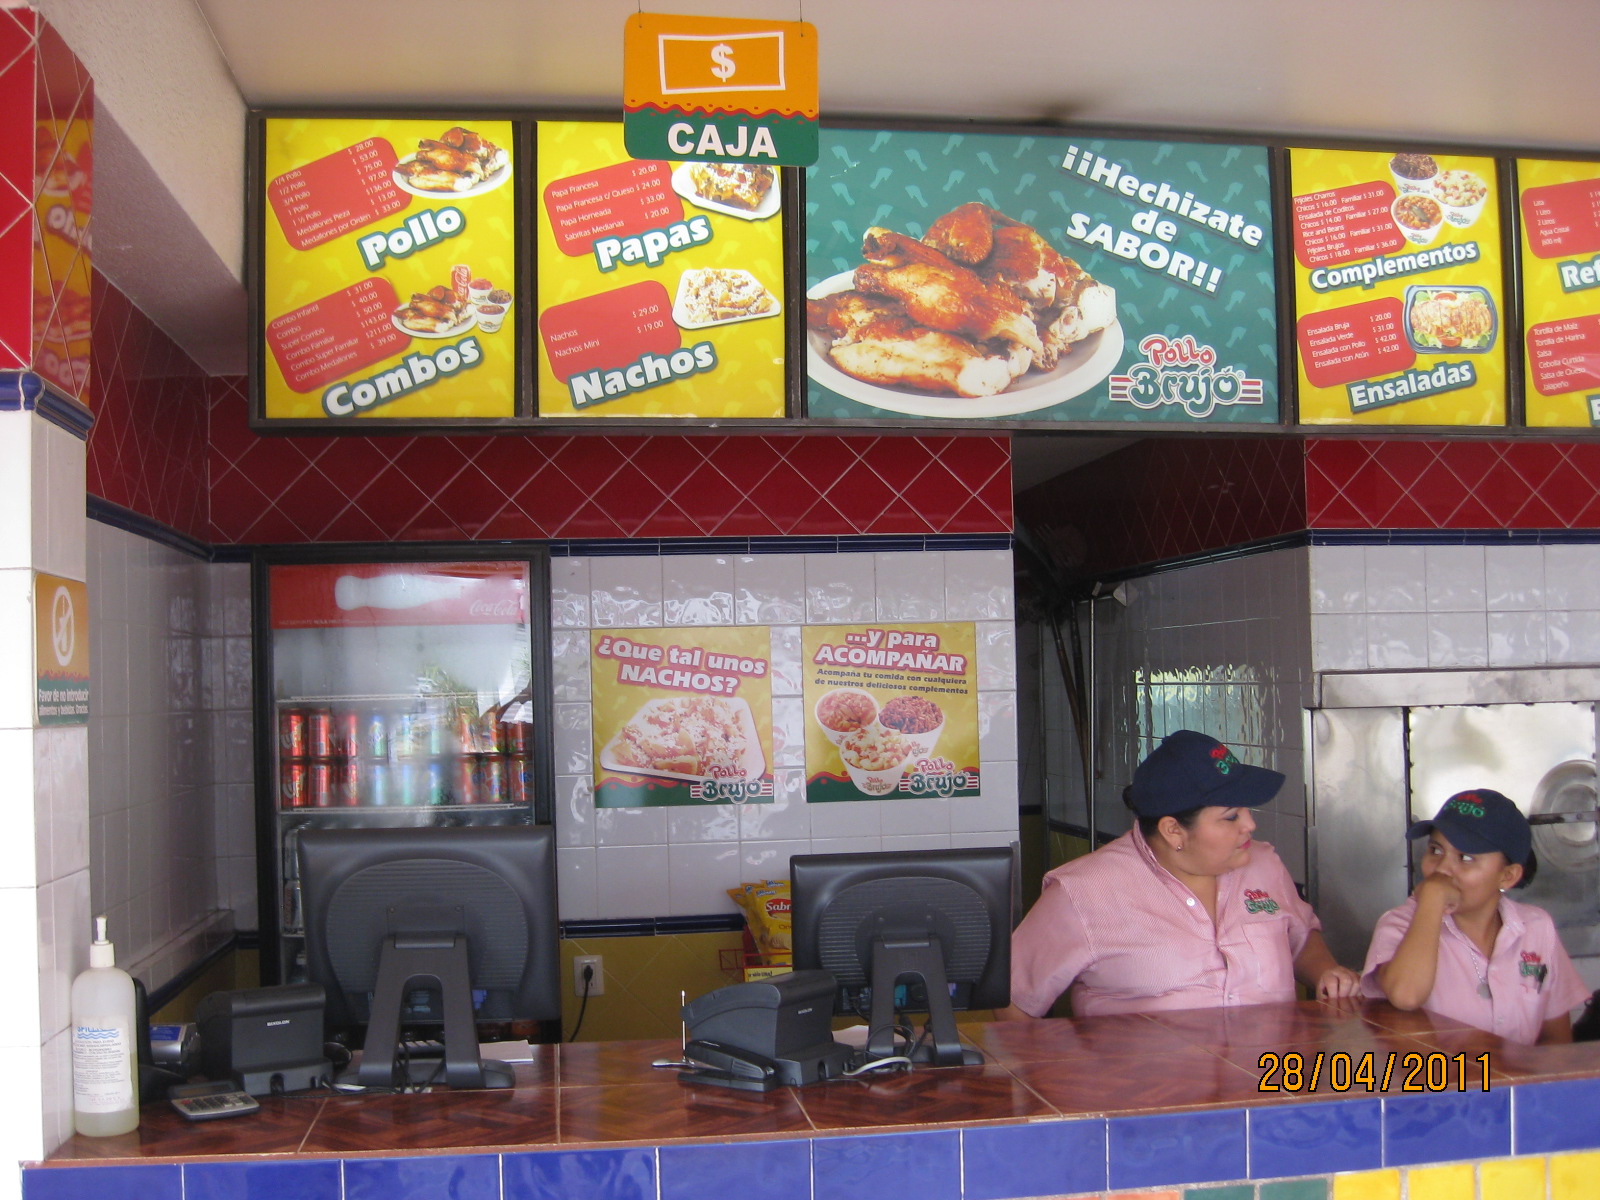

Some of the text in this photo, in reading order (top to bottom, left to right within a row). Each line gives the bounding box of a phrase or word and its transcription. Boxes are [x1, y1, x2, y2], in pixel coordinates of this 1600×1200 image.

[667, 122, 778, 159] CAJA
[285, 170, 302, 181] Pollo
[355, 139, 374, 153] 28.00
[290, 181, 306, 192] Pollo
[359, 149, 378, 163] 53.00
[293, 170, 387, 214] Pollo 97.00
[295, 191, 310, 201] Pollo
[364, 160, 383, 173] 75.00
[551, 164, 657, 199] Papa Francesa 20.00
[556, 179, 661, 213] Papa Francesa Queso 24.00
[560, 193, 665, 227] Papa Horneada 33.00
[1296, 189, 1384, 213] Chicos 16.00 Familiar 31.00
[1313, 191, 1336, 201] Charros
[296, 190, 396, 237] Medallones Pieza 13.00
[300, 200, 401, 247] Medallones por Orden 33.00
[306, 210, 322, 221] Pollo
[564, 207, 670, 242] Sabritas Medianas 20.00
[1131, 209, 1178, 243] de
[1298, 211, 1324, 221] Ensalada
[1332, 205, 1355, 214] Coditos
[1300, 206, 1389, 230] Chicos 14.00 Familiar 27.00
[360, 208, 462, 268] Pollo
[595, 217, 710, 270] Papas
[1304, 237, 1324, 247] Chicos
[1349, 227, 1371, 237] Familiar
[1376, 222, 1393, 232] 31.00
[1315, 228, 1327, 236] and
[1327, 224, 1345, 233] Beans
[1066, 212, 1223, 294] SABOR!!
[1309, 253, 1329, 263] Chicos
[1354, 244, 1375, 254] Familiar
[1326, 242, 1345, 251] Brujos
[1311, 242, 1478, 289] Complementos
[271, 281, 373, 329] Combo Infantil 31.00
[276, 291, 378, 340] Combo 40.00
[281, 301, 383, 350] Super Combo 50.00
[550, 304, 659, 343] Nachos 29.00
[1307, 312, 1392, 336] Ensalada Bruja 20.00
[1309, 323, 1394, 347] Ensalada Verde 31.00
[1533, 327, 1553, 336] Tortilla
[286, 346, 311, 360] Combo
[310, 335, 335, 350] Familiar
[555, 320, 664, 358] Nachos Mini 19.00
[1140, 335, 1216, 368] Pollo
[1312, 333, 1397, 358] Ensalada con Pollo 42.00
[1535, 337, 1555, 347] Tortilla
[1565, 333, 1585, 342] Harina
[1537, 350, 1552, 358] Salsa
[291, 357, 315, 372] Combo
[315, 349, 334, 361] Super
[334, 338, 359, 352] Familiar
[296, 367, 320, 382] Combo
[320, 351, 358, 372] Medallones
[1315, 357, 1342, 368] Ensalada
[1342, 354, 1353, 362] con
[1382, 344, 1400, 353] 42.00
[1538, 359, 1561, 369] Cebolla
[325, 338, 481, 416] Combos
[570, 344, 715, 405] Nachos
[1350, 363, 1473, 408] Ensaladas
[1540, 371, 1555, 380] Salsa
[1129, 364, 1240, 416] Brujo
[887, 632, 937, 649] para
[598, 638, 765, 675] ¿Que tal unos
[815, 646, 965, 672] ACOMPAÑAR
[620, 664, 739, 694] NACHOS?
[817, 668, 861, 679] Acompaña
[875, 672, 905, 681] comida
[906, 674, 921, 682] con
[923, 676, 967, 685] cualquiera
[827, 680, 864, 688] nuestros
[866, 681, 907, 691] deliciosos
[908, 684, 969, 695] complementos
[708, 764, 748, 779] Pollo
[915, 757, 955, 773] Pollo
[701, 778, 763, 804] Brujo
[909, 770, 968, 798] Brujo
[765, 901, 792, 912] Sabr
